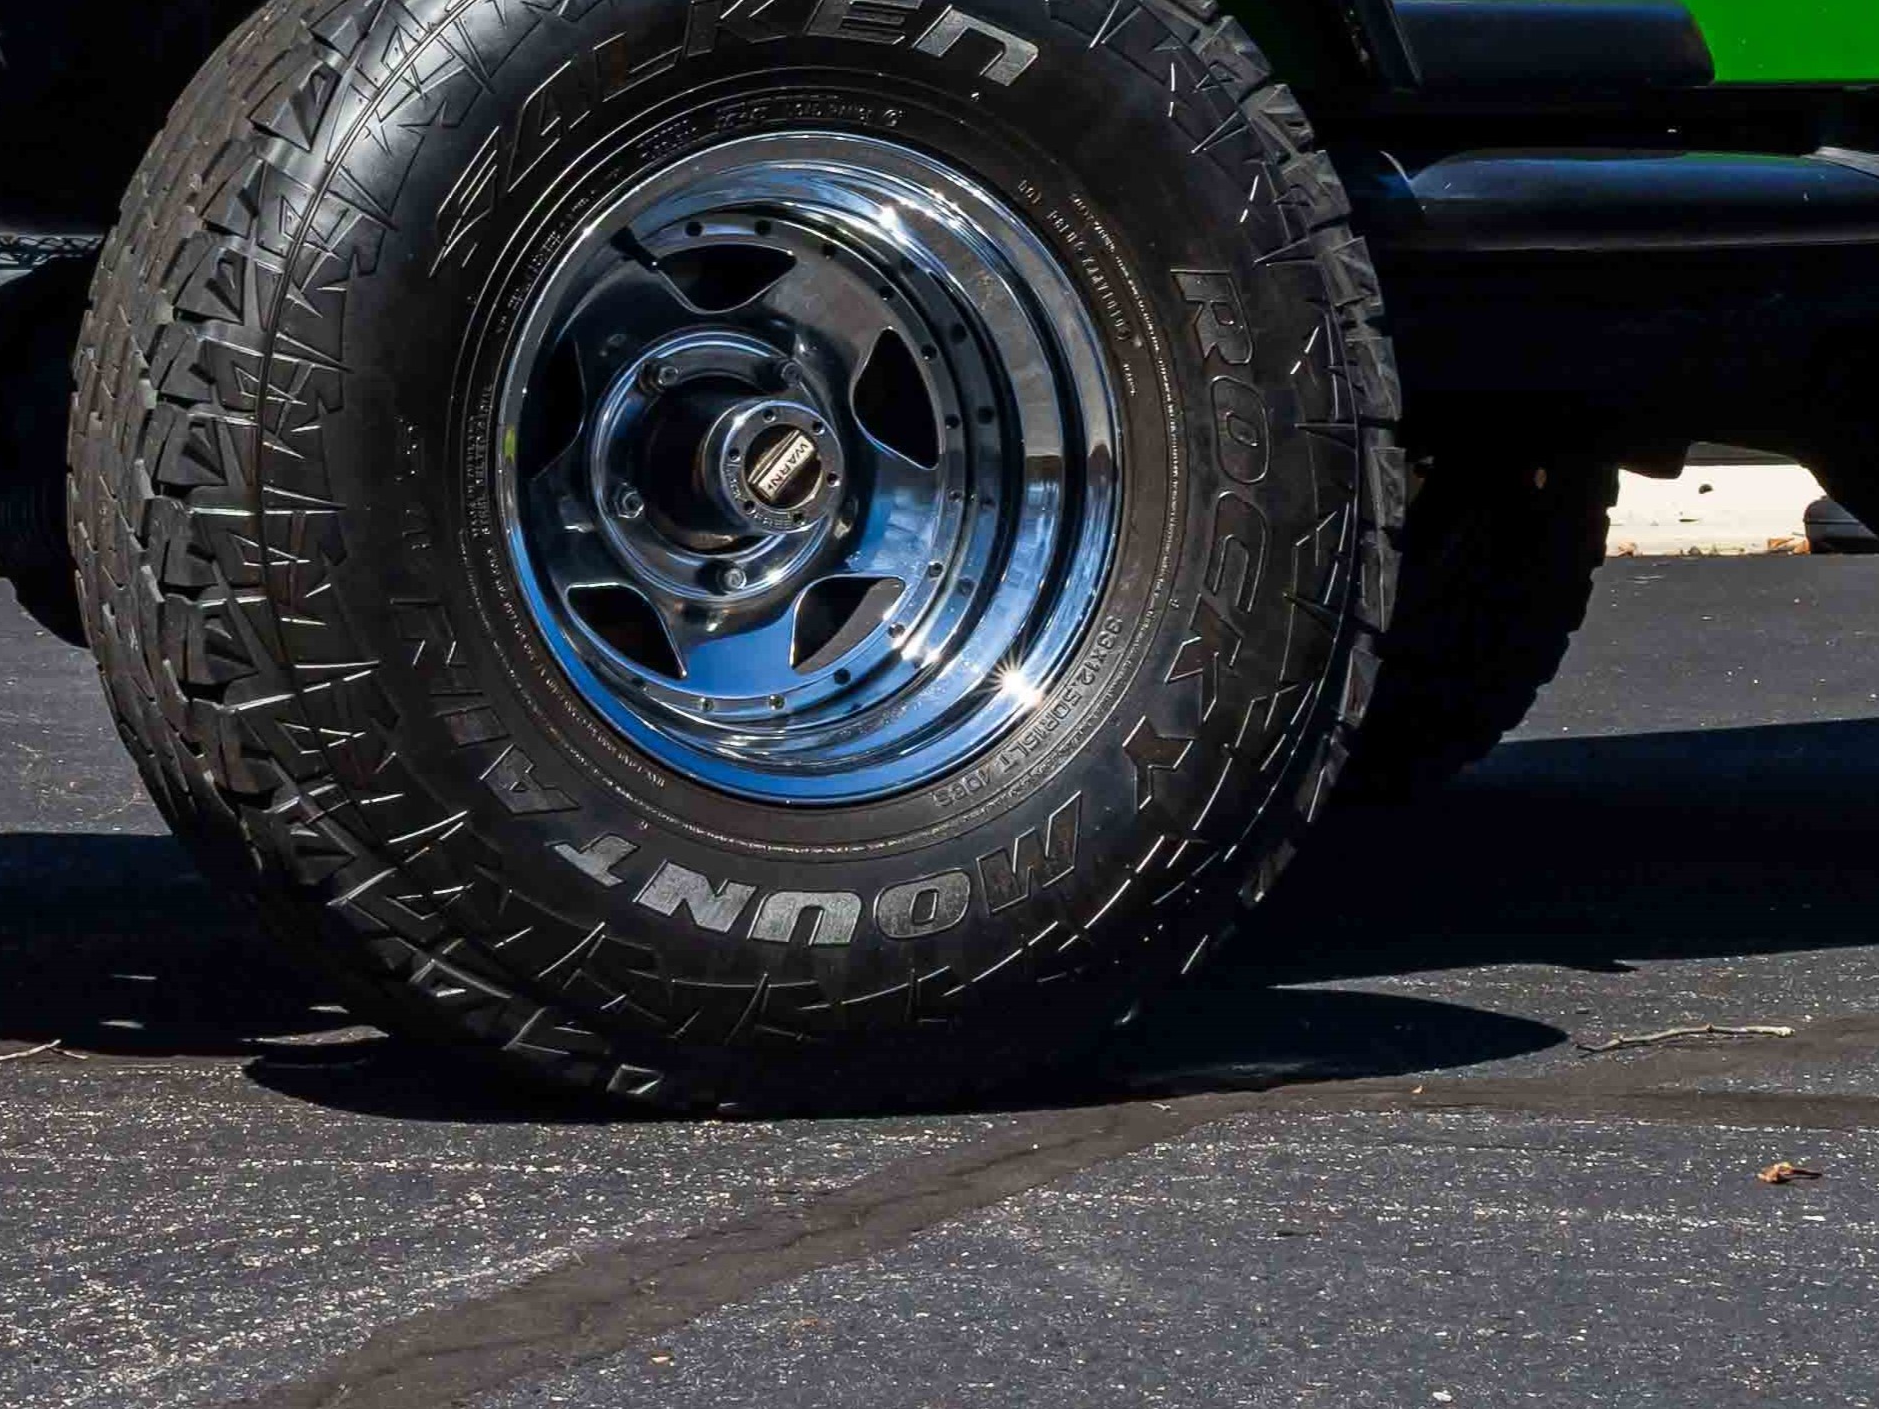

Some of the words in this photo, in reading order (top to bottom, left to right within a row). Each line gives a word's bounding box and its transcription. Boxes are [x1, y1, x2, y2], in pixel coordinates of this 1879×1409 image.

[768, 442, 810, 487] WARN
[1122, 269, 1270, 813] ROCKY
[390, 597, 1083, 947] MOUNTAIN
